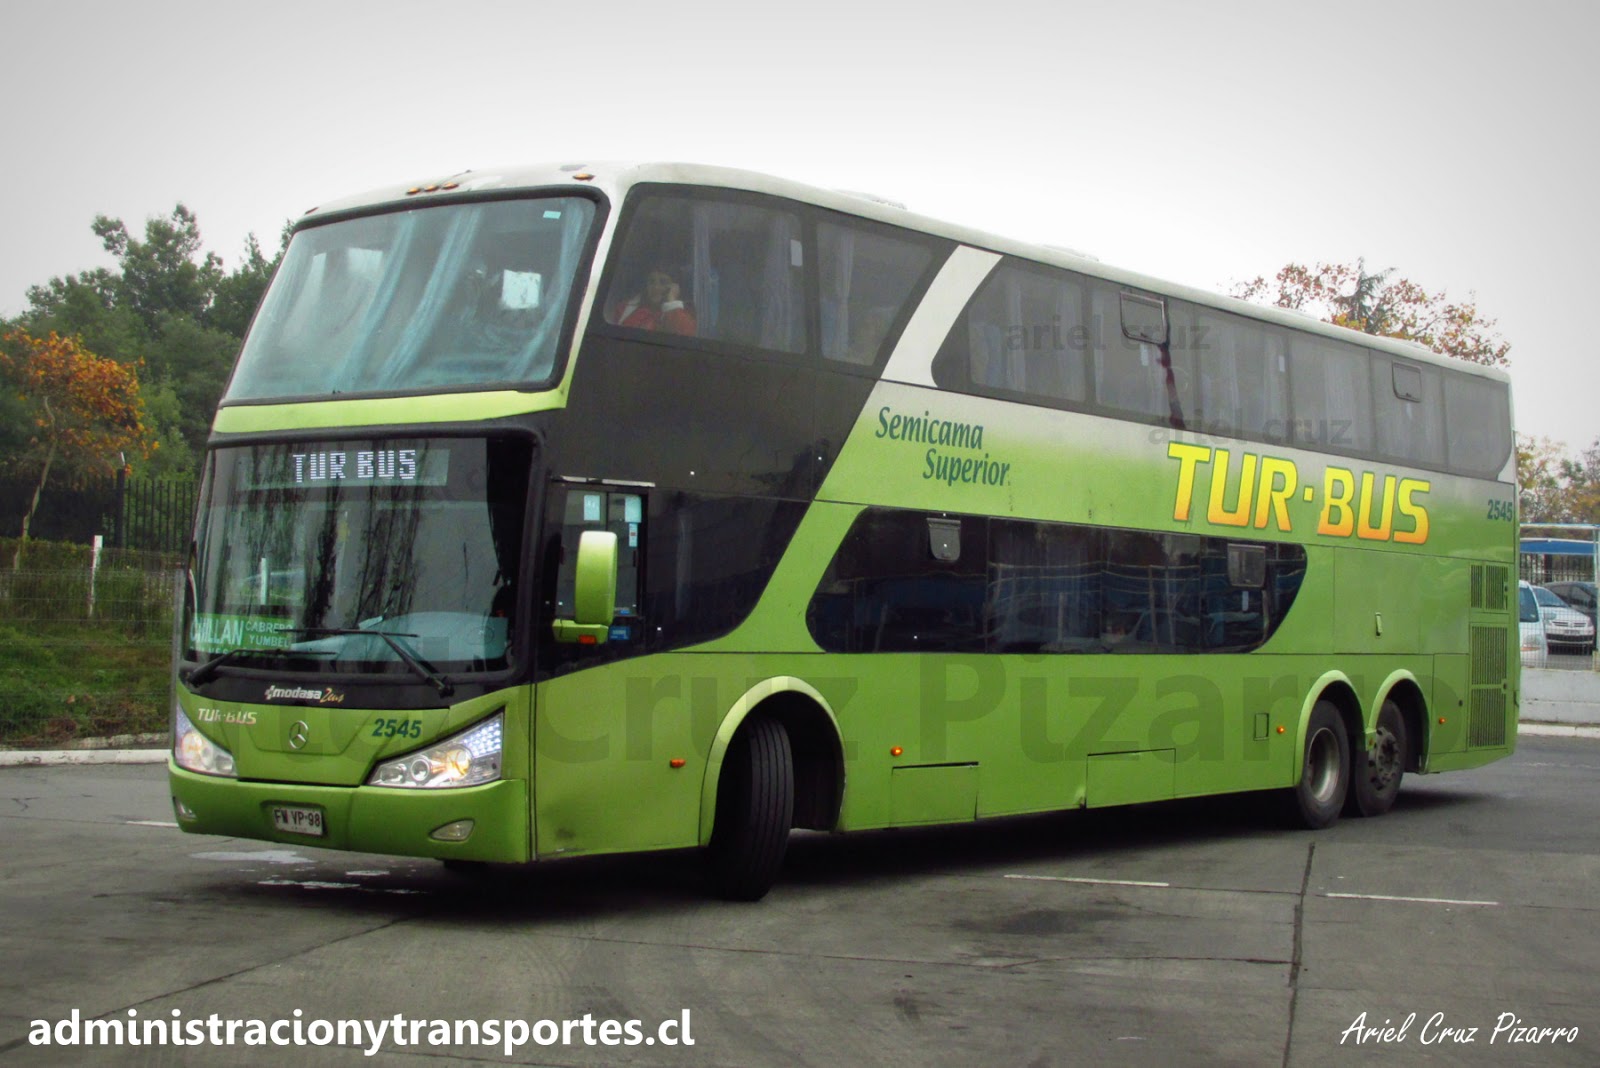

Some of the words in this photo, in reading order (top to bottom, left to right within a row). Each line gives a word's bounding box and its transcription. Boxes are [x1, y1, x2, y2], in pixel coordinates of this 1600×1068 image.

[875, 406, 984, 450] Semicama
[293, 452, 346, 483] TUR
[357, 450, 416, 480] BUS
[922, 448, 1010, 487] Superior
[1487, 499, 1513, 522] 2545
[272, 686, 322, 700] modasa
[372, 718, 422, 739] 2545
